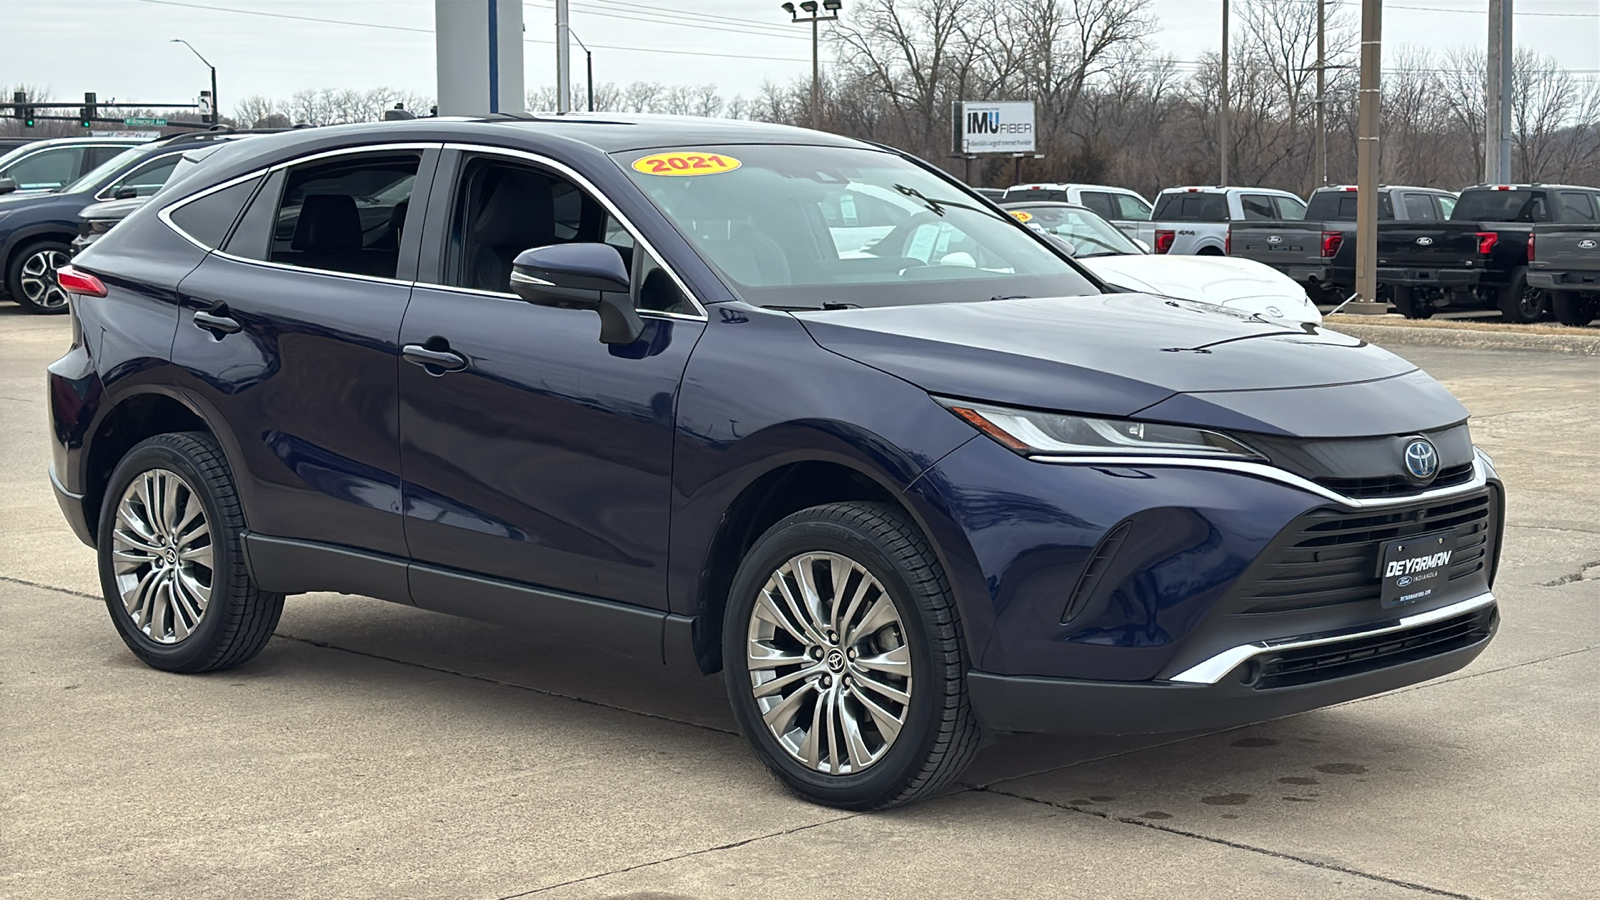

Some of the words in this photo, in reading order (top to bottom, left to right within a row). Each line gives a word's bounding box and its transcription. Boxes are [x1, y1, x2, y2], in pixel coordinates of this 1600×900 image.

[967, 112, 999, 134] IMU
[1000, 123, 1032, 134] FIBER
[646, 155, 728, 172] 2021
[1386, 550, 1452, 578] DEYARMAN
[1413, 571, 1438, 582] INDIANOLA
